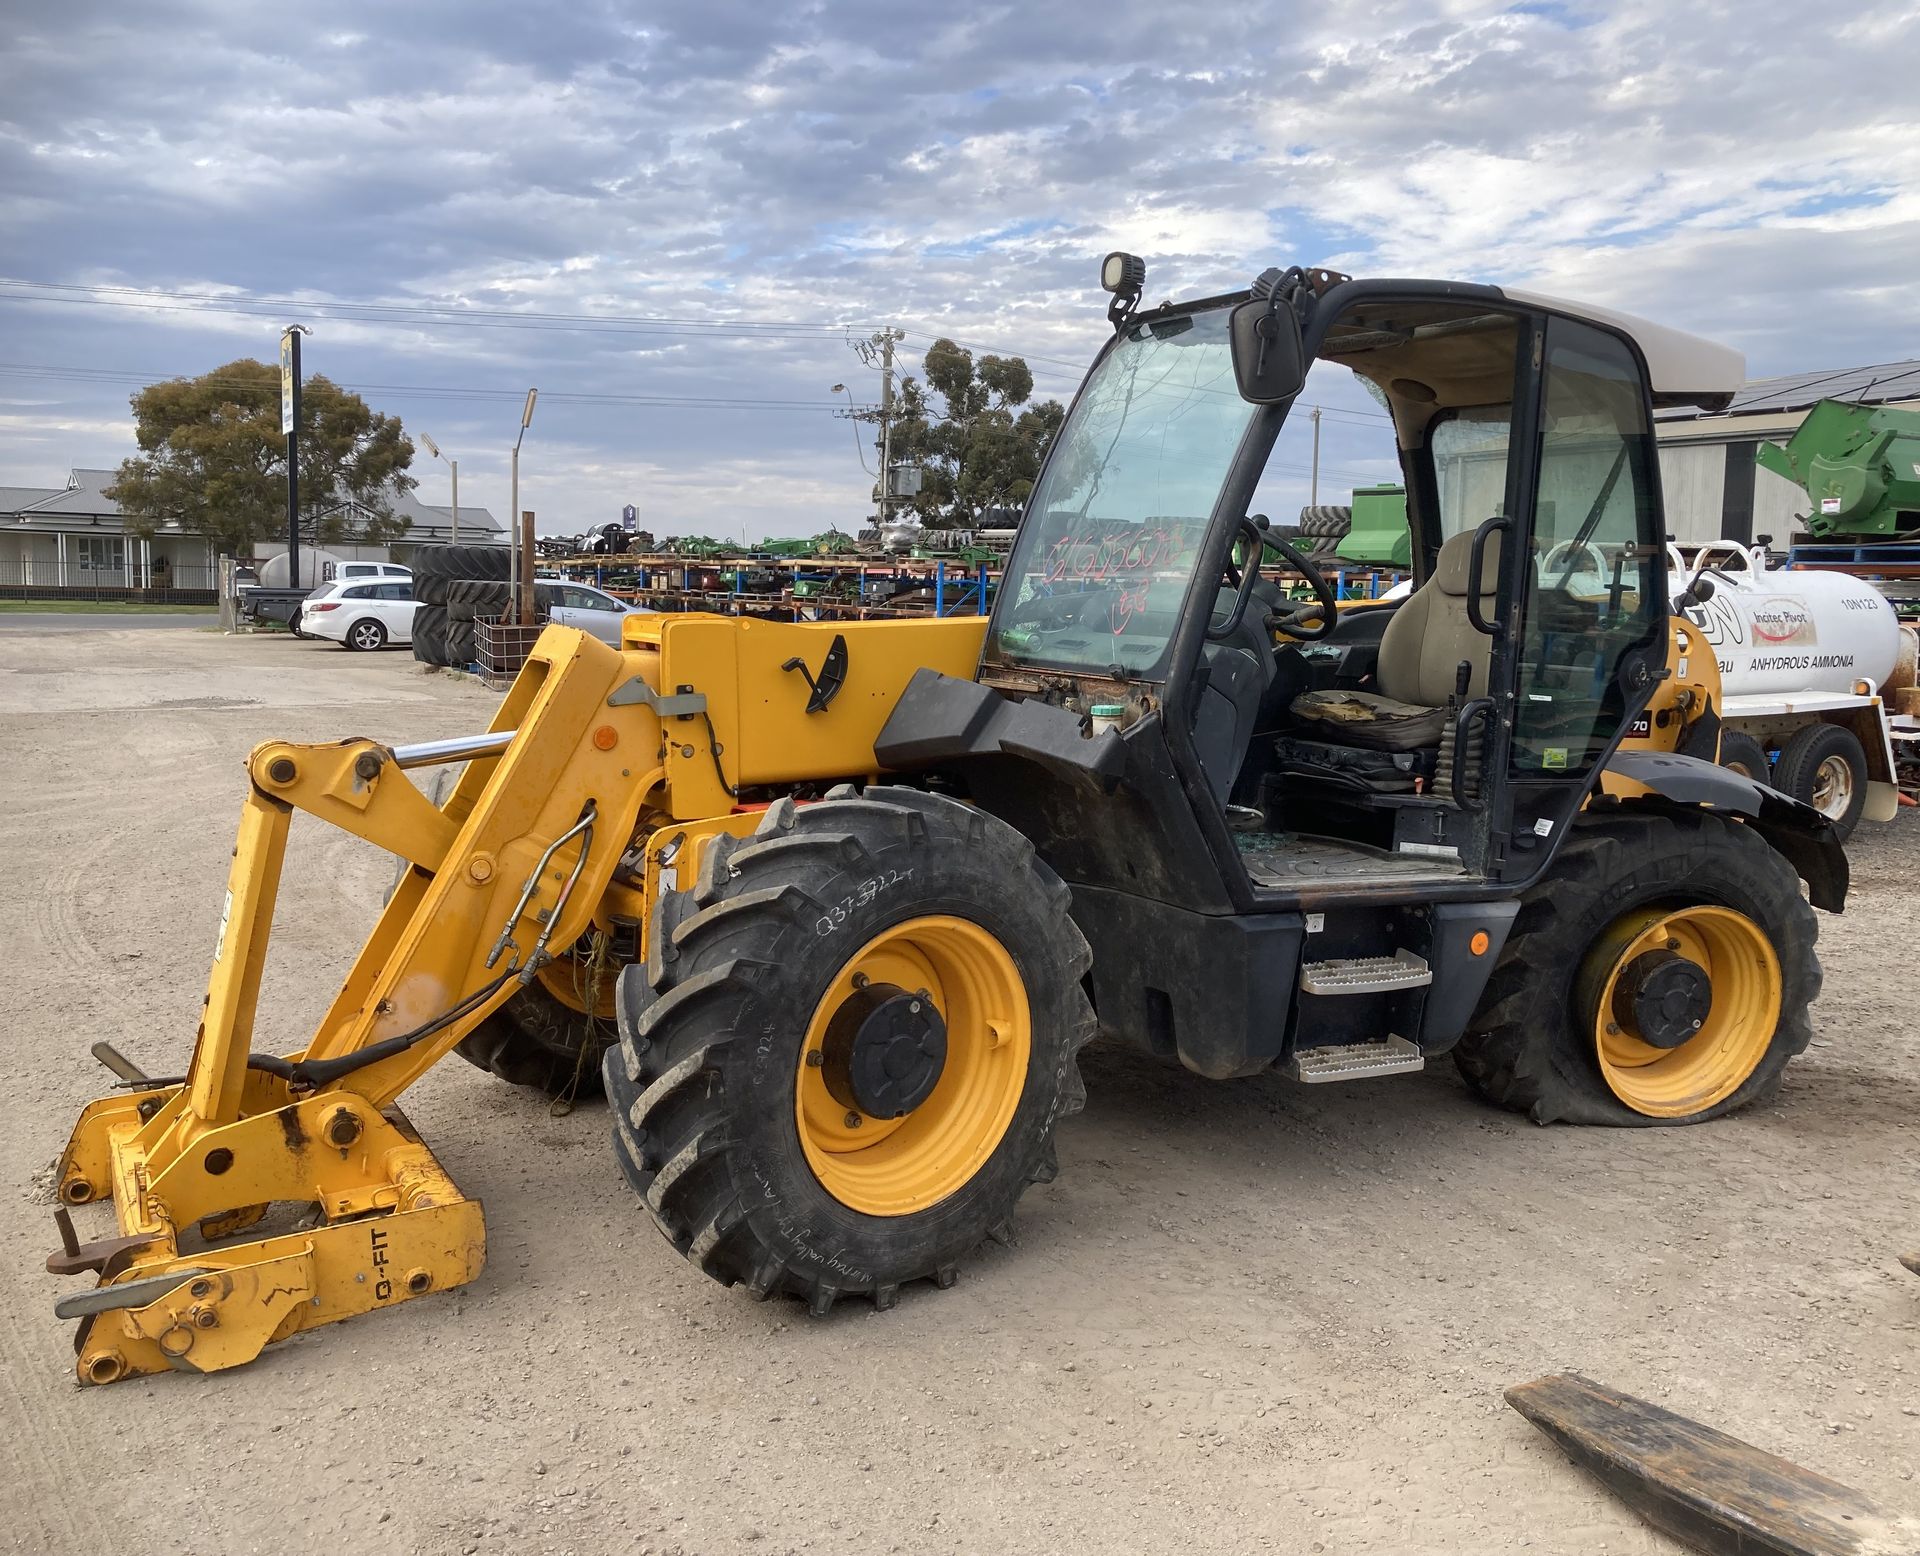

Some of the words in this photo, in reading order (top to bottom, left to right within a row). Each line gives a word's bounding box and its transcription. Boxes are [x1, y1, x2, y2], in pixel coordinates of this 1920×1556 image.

[1841, 598, 1879, 611] 10N123
[1753, 611, 1784, 624] Incitec
[1782, 610, 1808, 624] Pivot
[1749, 656, 1810, 671] ANHYDROUS
[1810, 655, 1855, 669] AMMONIA
[370, 1228, 392, 1300] Q-FIT
